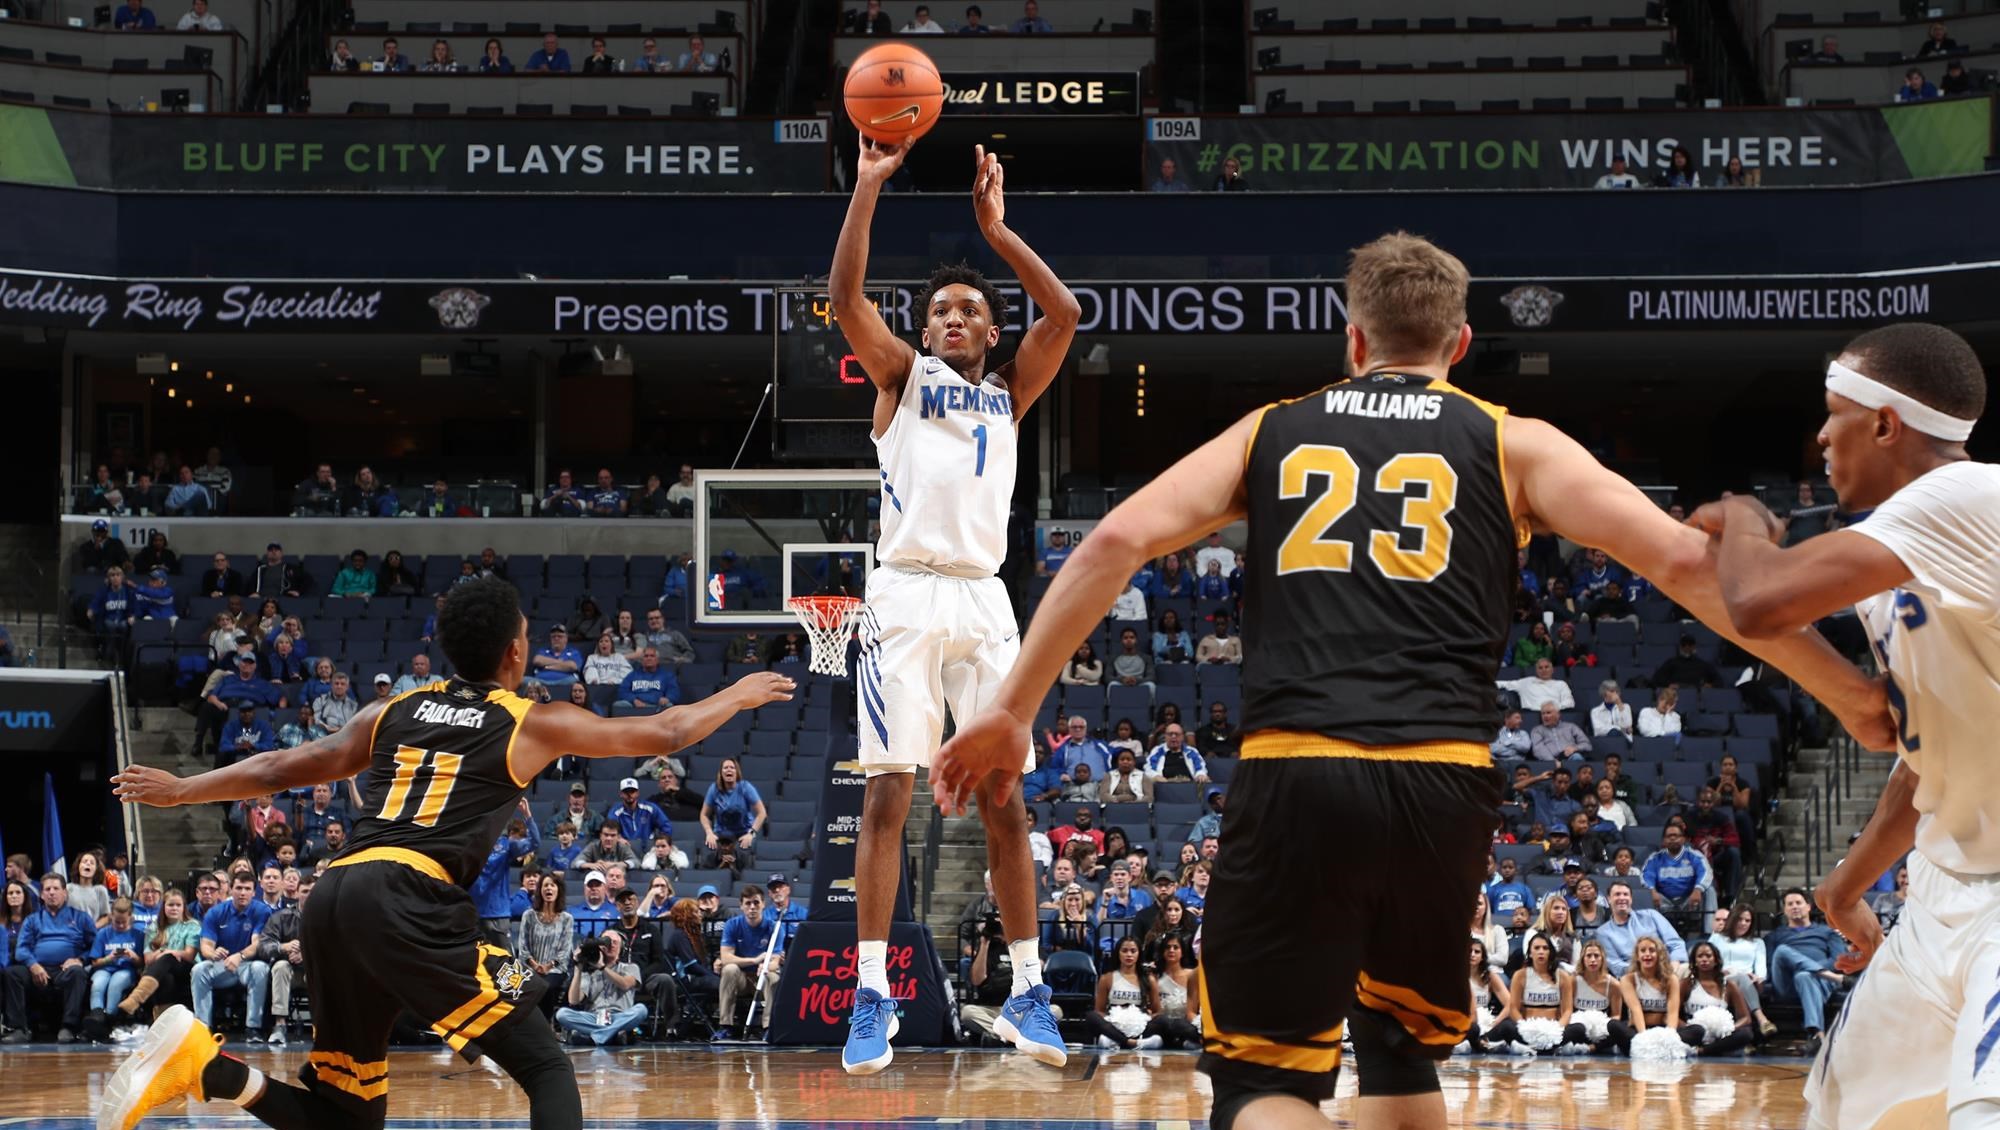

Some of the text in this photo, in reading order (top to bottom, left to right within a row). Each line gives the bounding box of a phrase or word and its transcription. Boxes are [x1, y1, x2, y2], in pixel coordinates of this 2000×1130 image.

[996, 82, 1104, 104] LEDGE
[784, 121, 823, 139] 110A
[1155, 120, 1197, 138] 109A
[183, 142, 755, 174] BLUFF CITY PLAYS HERE.
[1196, 140, 1540, 173] #GRIZZNATION
[1702, 136, 1838, 168] HERE.
[0, 279, 382, 329] edding Ring Specialist
[554, 295, 729, 331] Presents
[1628, 284, 1930, 319] PLATINUMJEWELERS.COM
[920, 385, 1013, 420] MEMPHI
[1324, 390, 1443, 420] WILLIAMS
[972, 423, 988, 477] 1
[1277, 443, 1459, 582] 23
[376, 744, 465, 828] 11
[827, 824, 855, 832] CHEVY
[837, 816, 861, 824] MID-S
[805, 949, 836, 979] I
[799, 974, 917, 1024] Memis
[1527, 992, 1559, 1003] MEMPHIS
